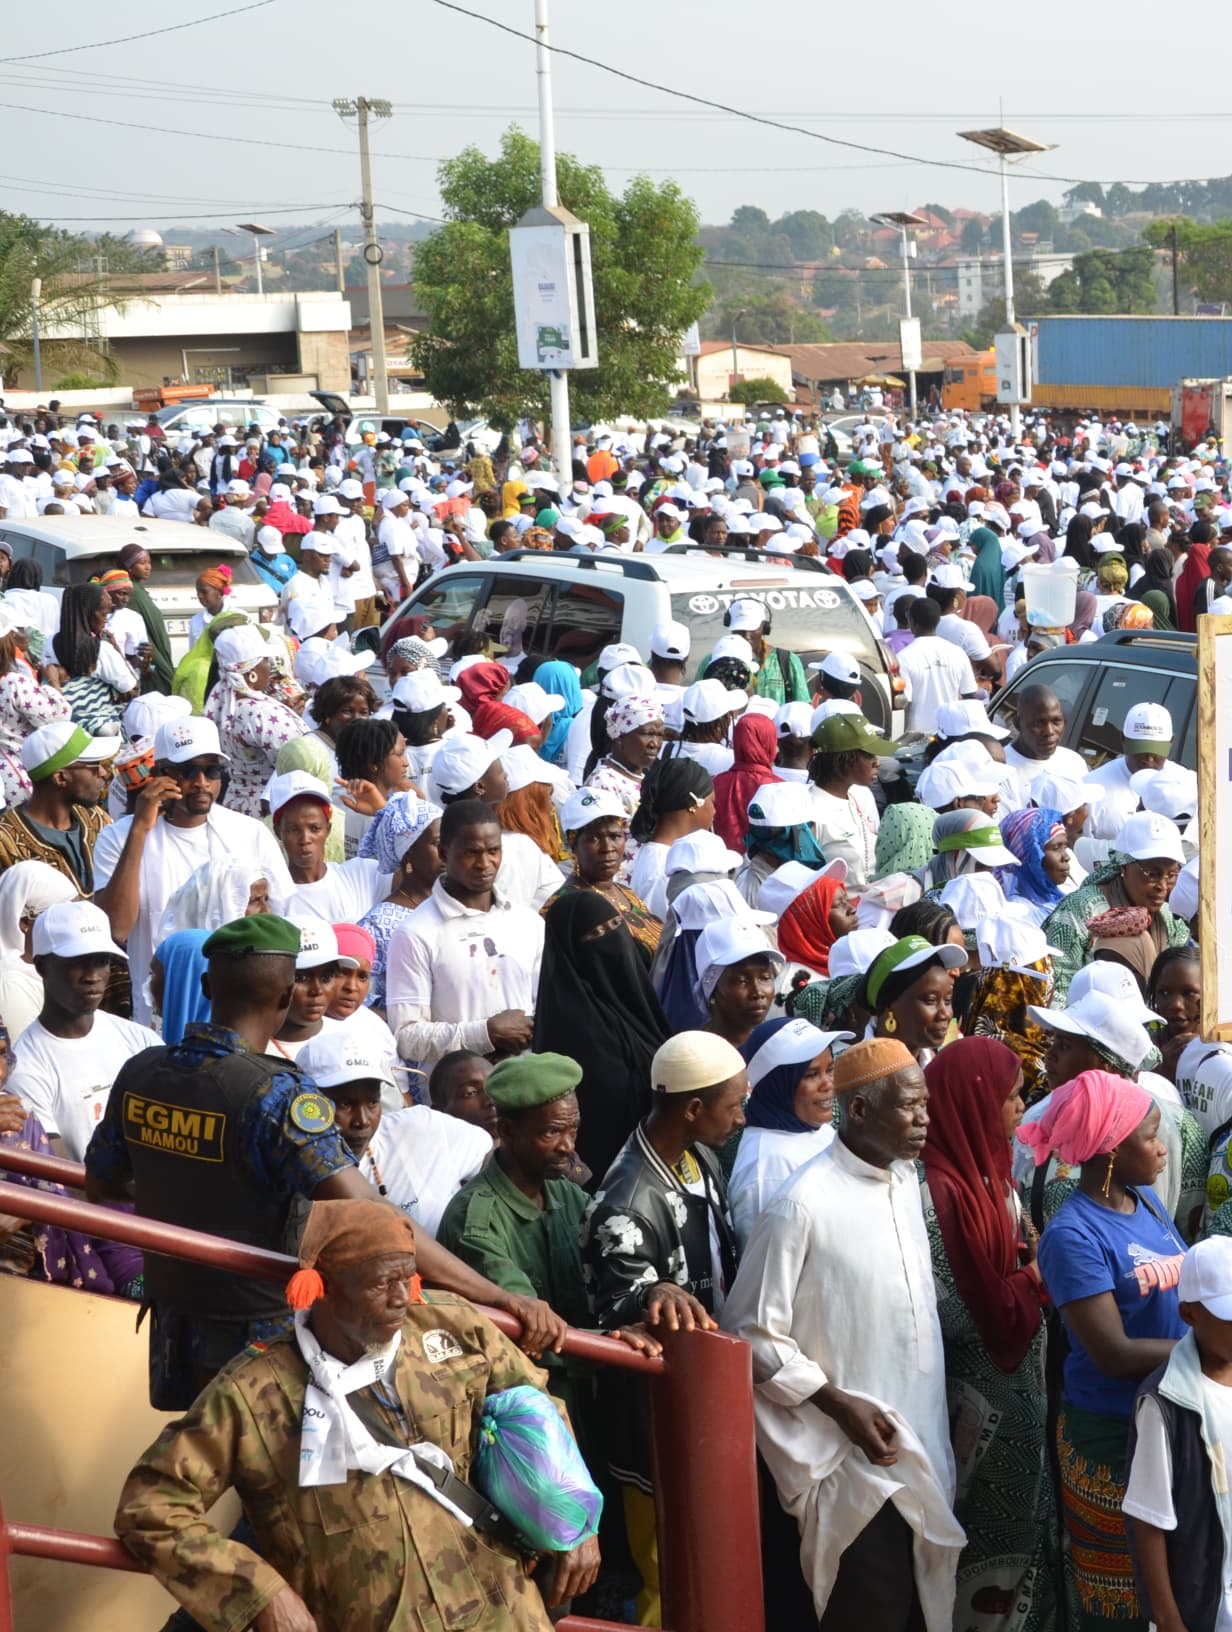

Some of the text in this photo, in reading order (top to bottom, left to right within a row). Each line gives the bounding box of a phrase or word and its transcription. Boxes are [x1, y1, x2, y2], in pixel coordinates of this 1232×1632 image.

[175, 739, 193, 748] GMD
[127, 1098, 216, 1140] EGMI
[141, 1127, 198, 1154] MAMOU
